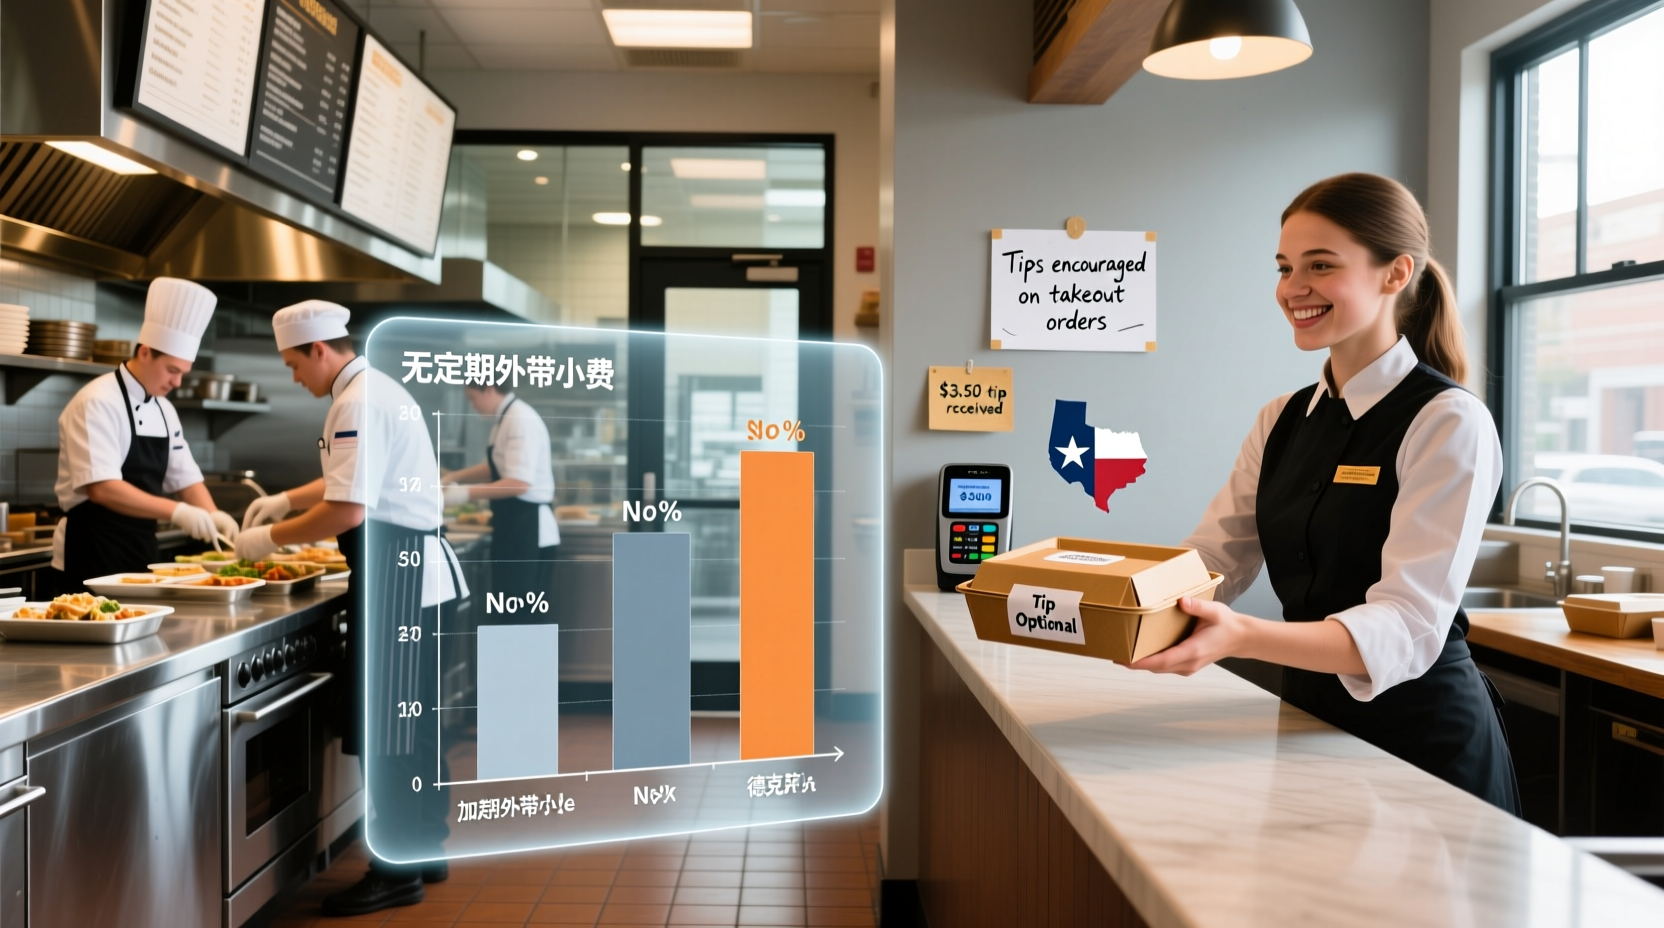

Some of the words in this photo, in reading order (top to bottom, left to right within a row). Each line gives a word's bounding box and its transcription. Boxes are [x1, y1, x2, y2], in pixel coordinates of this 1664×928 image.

[1002, 250, 1044, 283] Tips
[1052, 251, 1147, 283] encouraged
[1019, 292, 1040, 304] on
[1049, 283, 1125, 303] takeout
[1046, 309, 1107, 330] orders
[940, 381, 981, 398] $3.50
[987, 385, 1007, 402] tip
[1032, 594, 1055, 615] Tip
[1016, 612, 1077, 634] Optional
